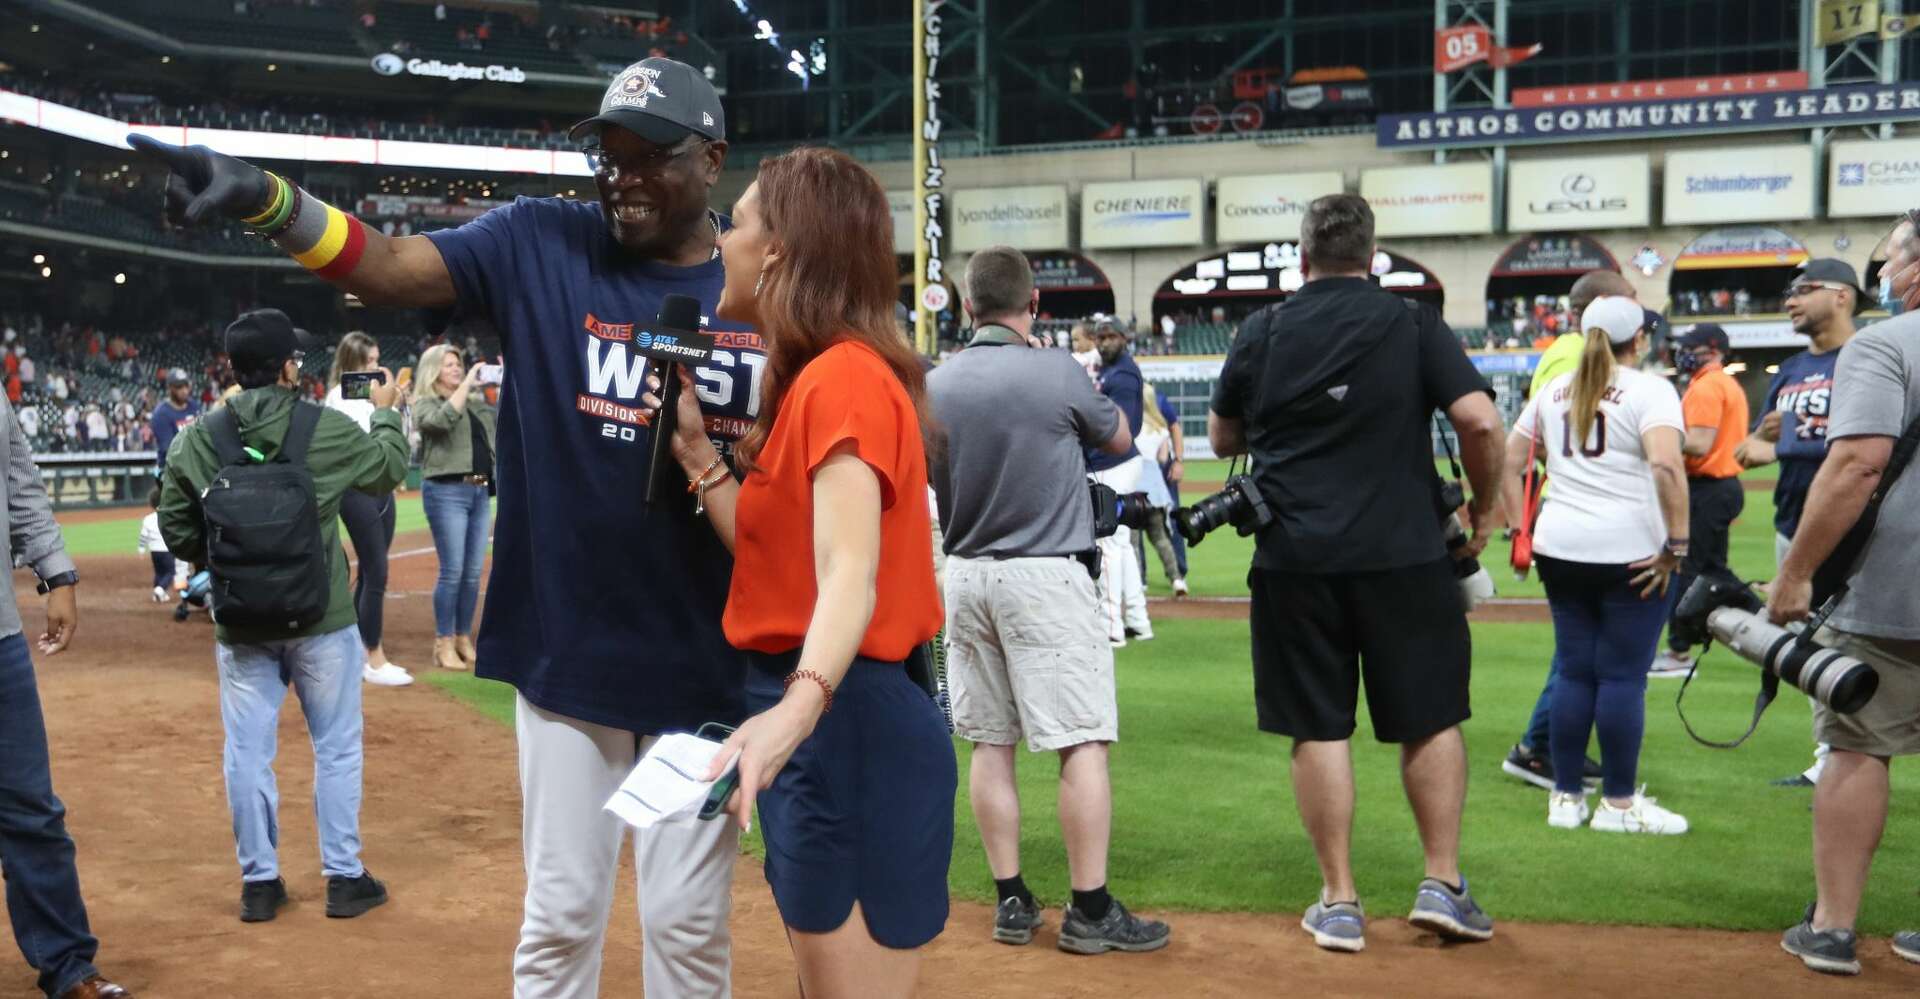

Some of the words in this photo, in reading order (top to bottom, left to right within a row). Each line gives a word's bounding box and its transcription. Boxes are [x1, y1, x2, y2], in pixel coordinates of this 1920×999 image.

[1831, 6, 1863, 31] 17
[1445, 33, 1479, 59] 05
[407, 58, 483, 81] Gallagher
[485, 65, 526, 83] Club
[1396, 113, 1520, 140] ASTROS
[1534, 99, 1757, 132] COMMUNITY
[1685, 174, 1793, 194] Schlumberger
[957, 203, 1062, 225] lyondellbasell
[1093, 195, 1191, 214] CHENIERE
[1528, 199, 1627, 214] LEXUS
[925, 193, 943, 282] FAIR
[651, 341, 708, 359] SPORTSNET
[652, 334, 679, 346] AT&T
[586, 335, 768, 418] WST
[579, 396, 638, 423] DIVISION
[601, 422, 636, 443] 20
[1562, 409, 1606, 459] 10
